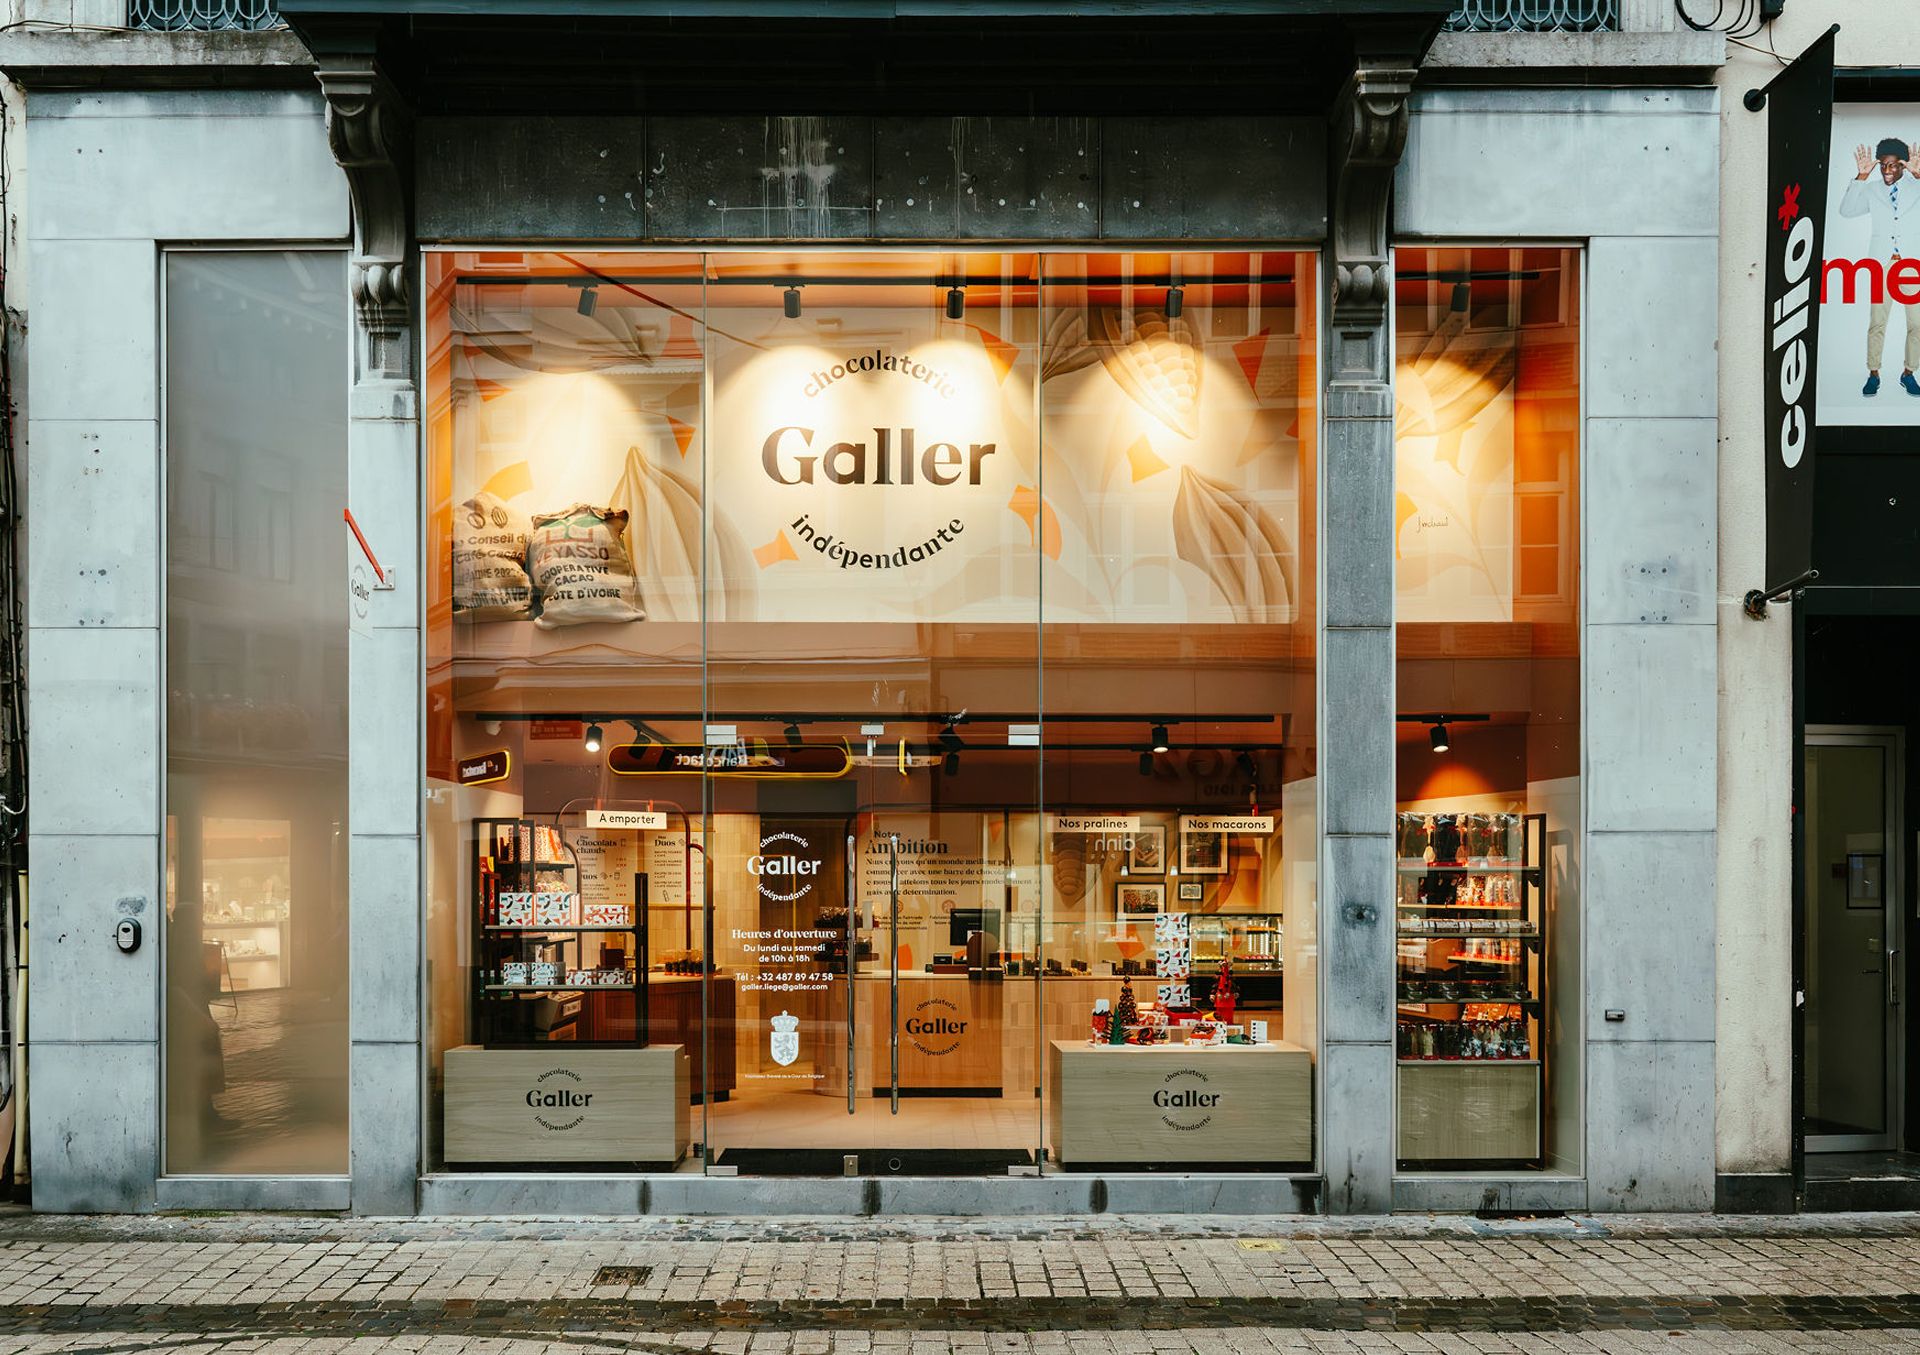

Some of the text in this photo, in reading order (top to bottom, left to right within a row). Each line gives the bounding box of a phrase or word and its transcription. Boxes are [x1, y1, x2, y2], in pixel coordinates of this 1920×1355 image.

[1773, 216, 1814, 469] celio
[803, 349, 957, 399] chocolaterie
[762, 425, 996, 486] Galler
[791, 514, 964, 569] indépendante
[554, 574, 594, 587] CACAO
[577, 587, 621, 599] D'IVOIRE
[609, 815, 655, 826] emporter
[1059, 818, 1128, 831] Nos pralines
[1188, 819, 1266, 830] Nos macarons
[576, 838, 617, 847] Chocolats
[654, 839, 676, 847] Duos
[760, 831, 809, 848] chocolaterie
[576, 846, 606, 854] chauds
[746, 855, 822, 875] Galler
[756, 883, 813, 901] indépendante
[732, 928, 837, 939] Heures d'ouverture
[743, 944, 755, 952] Du
[757, 944, 779, 952] lundi
[794, 944, 826, 952] samedi
[759, 955, 770, 963] de
[771, 954, 786, 963] 10h
[796, 954, 810, 963] 18h
[756, 972, 774, 981] +32
[775, 972, 793, 981] 487
[794, 972, 807, 981] 89
[808, 972, 820, 981] 47
[821, 972, 834, 981] 58
[741, 983, 828, 992] galler.liege@galler.com
[905, 1018, 968, 1035] Galler
[537, 1068, 582, 1082] chocolaterie
[1164, 1068, 1208, 1082] chocolaterie
[526, 1089, 593, 1107] Galler
[1153, 1090, 1220, 1108] Galler
